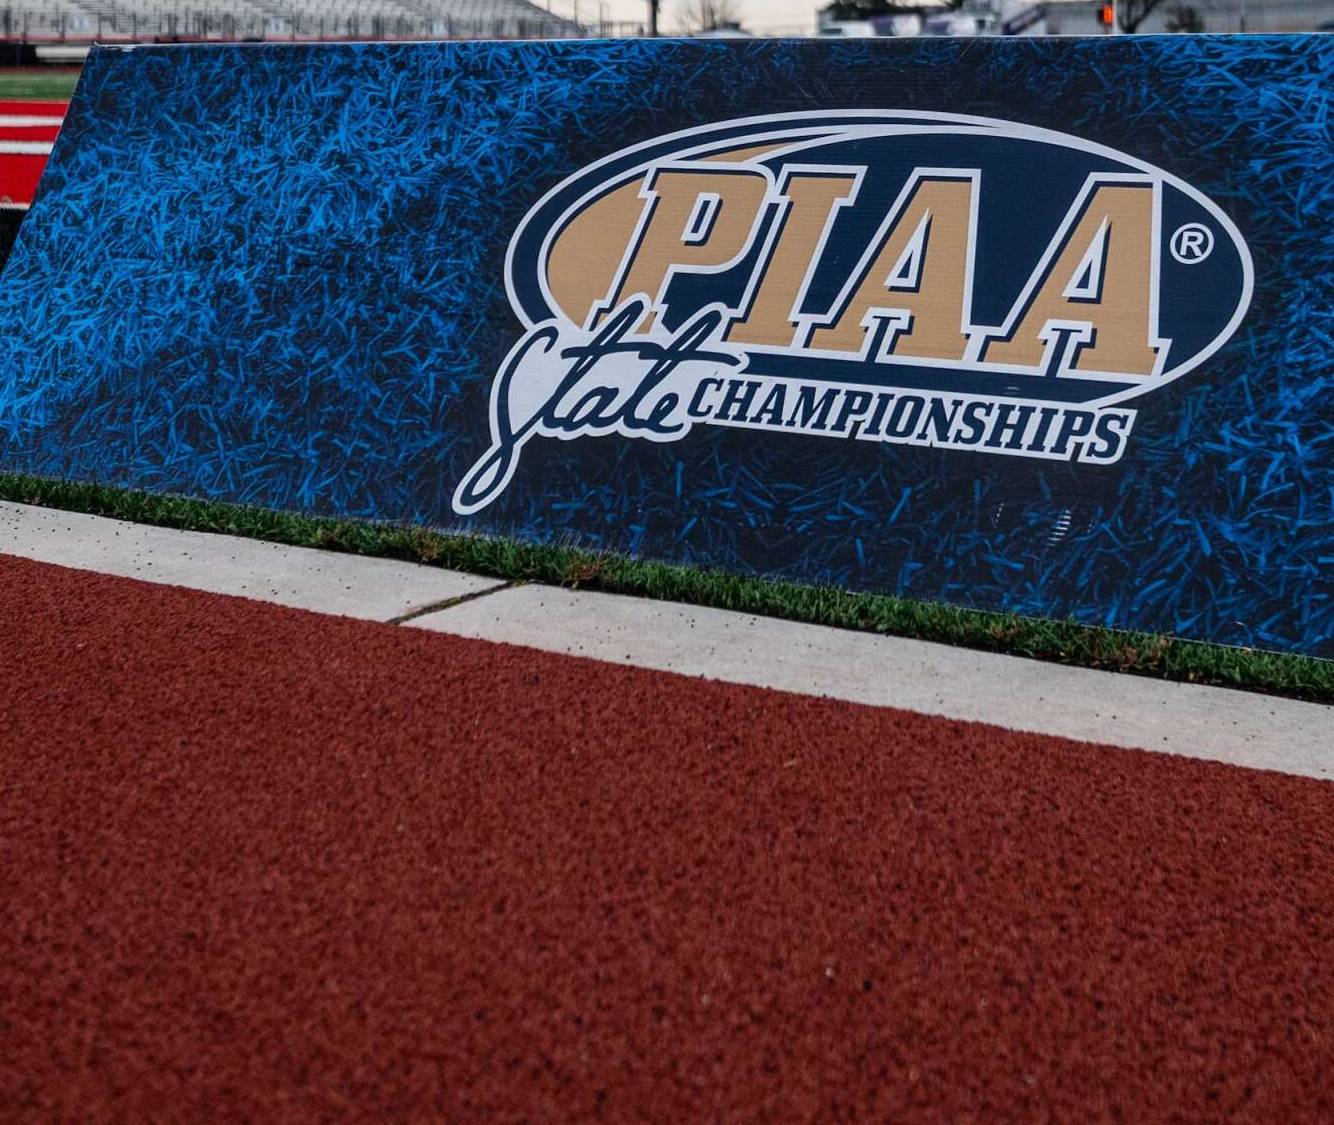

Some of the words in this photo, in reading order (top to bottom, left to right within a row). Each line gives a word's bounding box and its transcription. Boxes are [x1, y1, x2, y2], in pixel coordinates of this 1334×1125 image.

[591, 161, 1171, 379] PIAA
[455, 297, 748, 511] State
[689, 376, 1128, 459] CHAMPIONSHIPS
